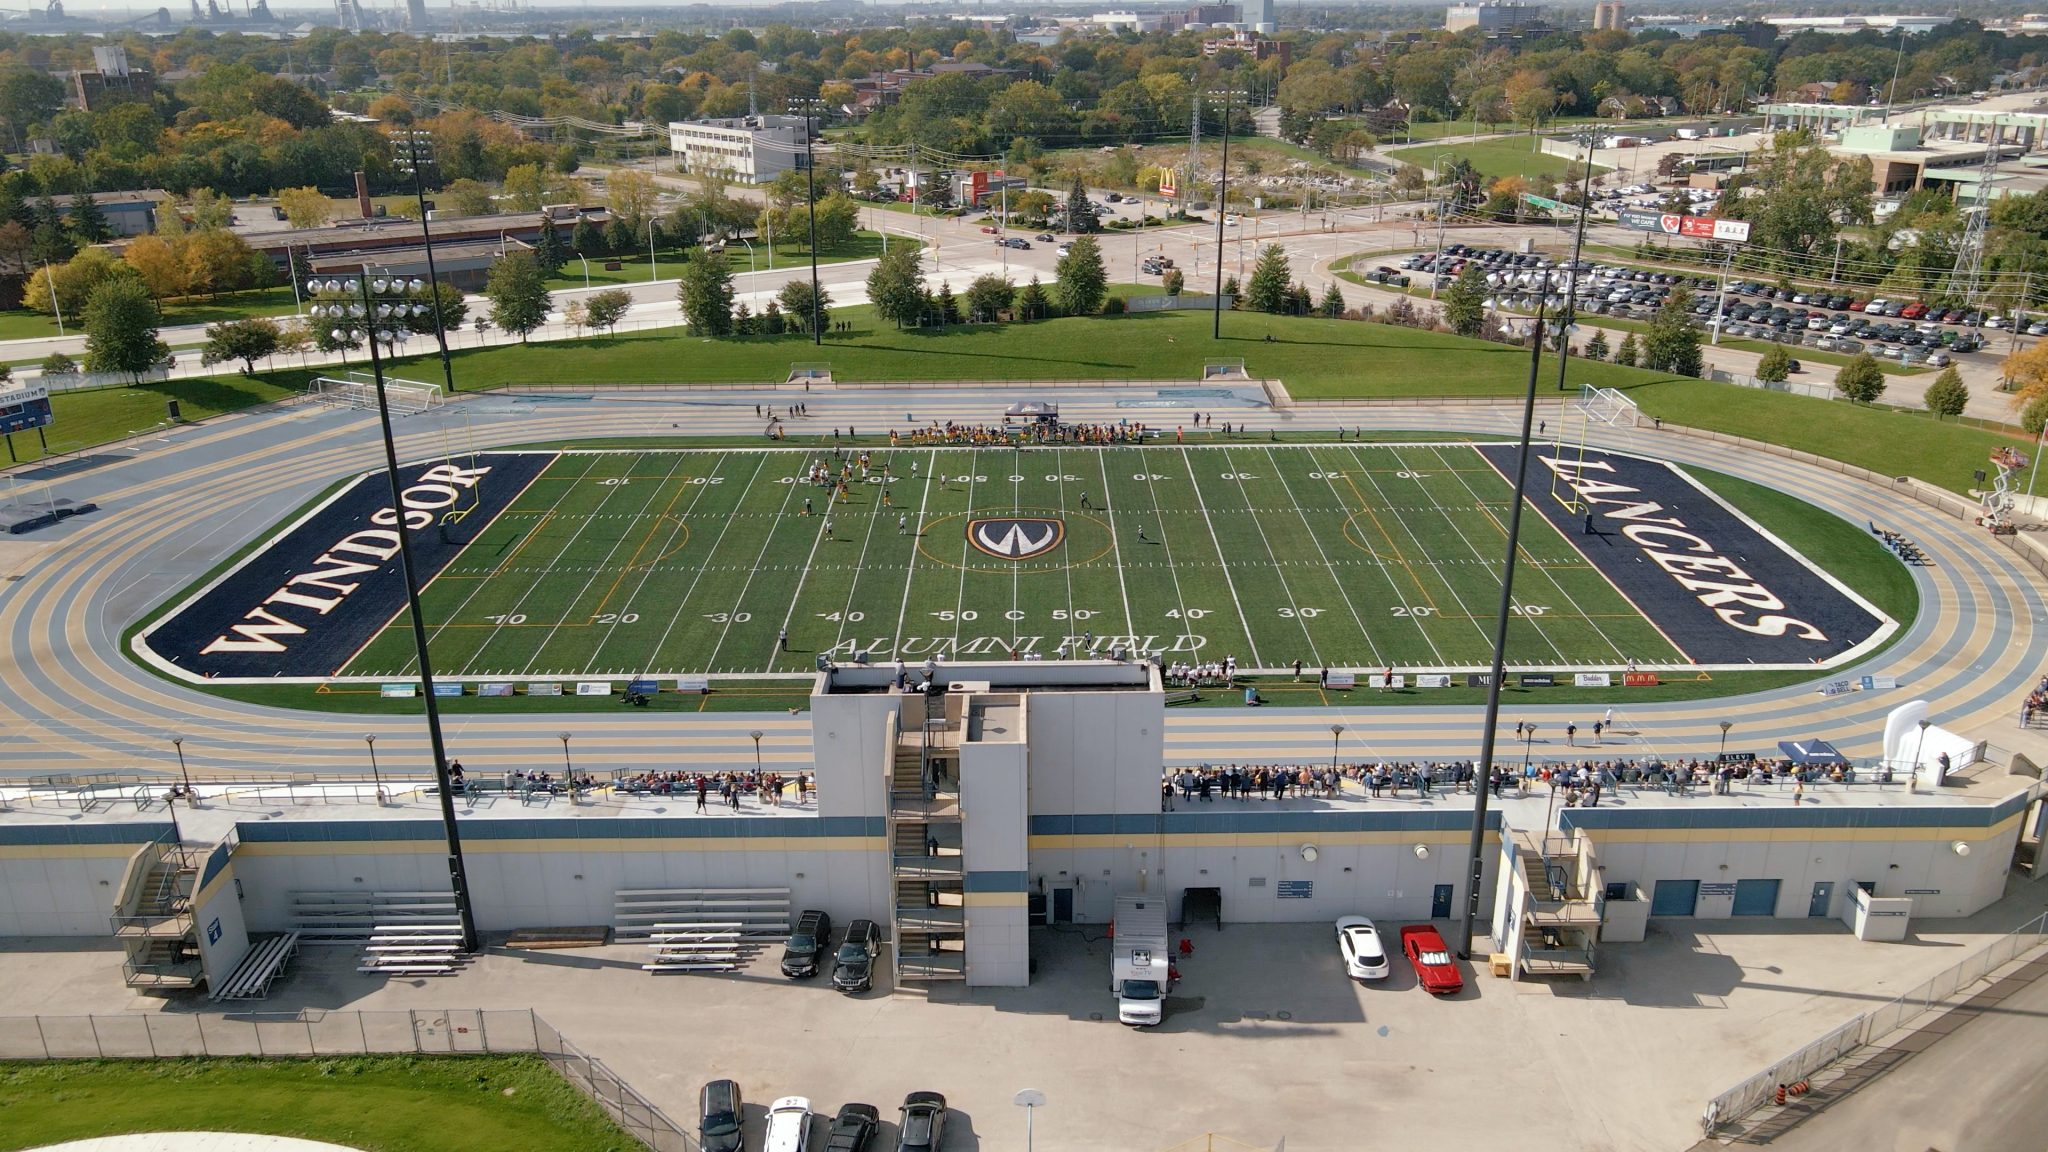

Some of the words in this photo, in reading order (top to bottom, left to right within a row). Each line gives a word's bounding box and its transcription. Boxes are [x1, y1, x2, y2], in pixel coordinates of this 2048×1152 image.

[1537, 455, 1830, 642] LANCERS
[199, 462, 493, 656] WINDSOR
[939, 610, 978, 621] 50
[1005, 610, 1026, 620] C
[1052, 609, 1092, 620] 50
[1165, 608, 1204, 619] 40
[1277, 607, 1318, 618] 30
[1390, 606, 1431, 617] 20
[1511, 605, 1543, 616] 10
[493, 613, 527, 625] 10
[597, 613, 640, 624] 20
[711, 612, 751, 623] 30
[826, 611, 864, 622] 40
[820, 636, 1045, 656] ALUMNI
[1052, 634, 1208, 653] FIELD
